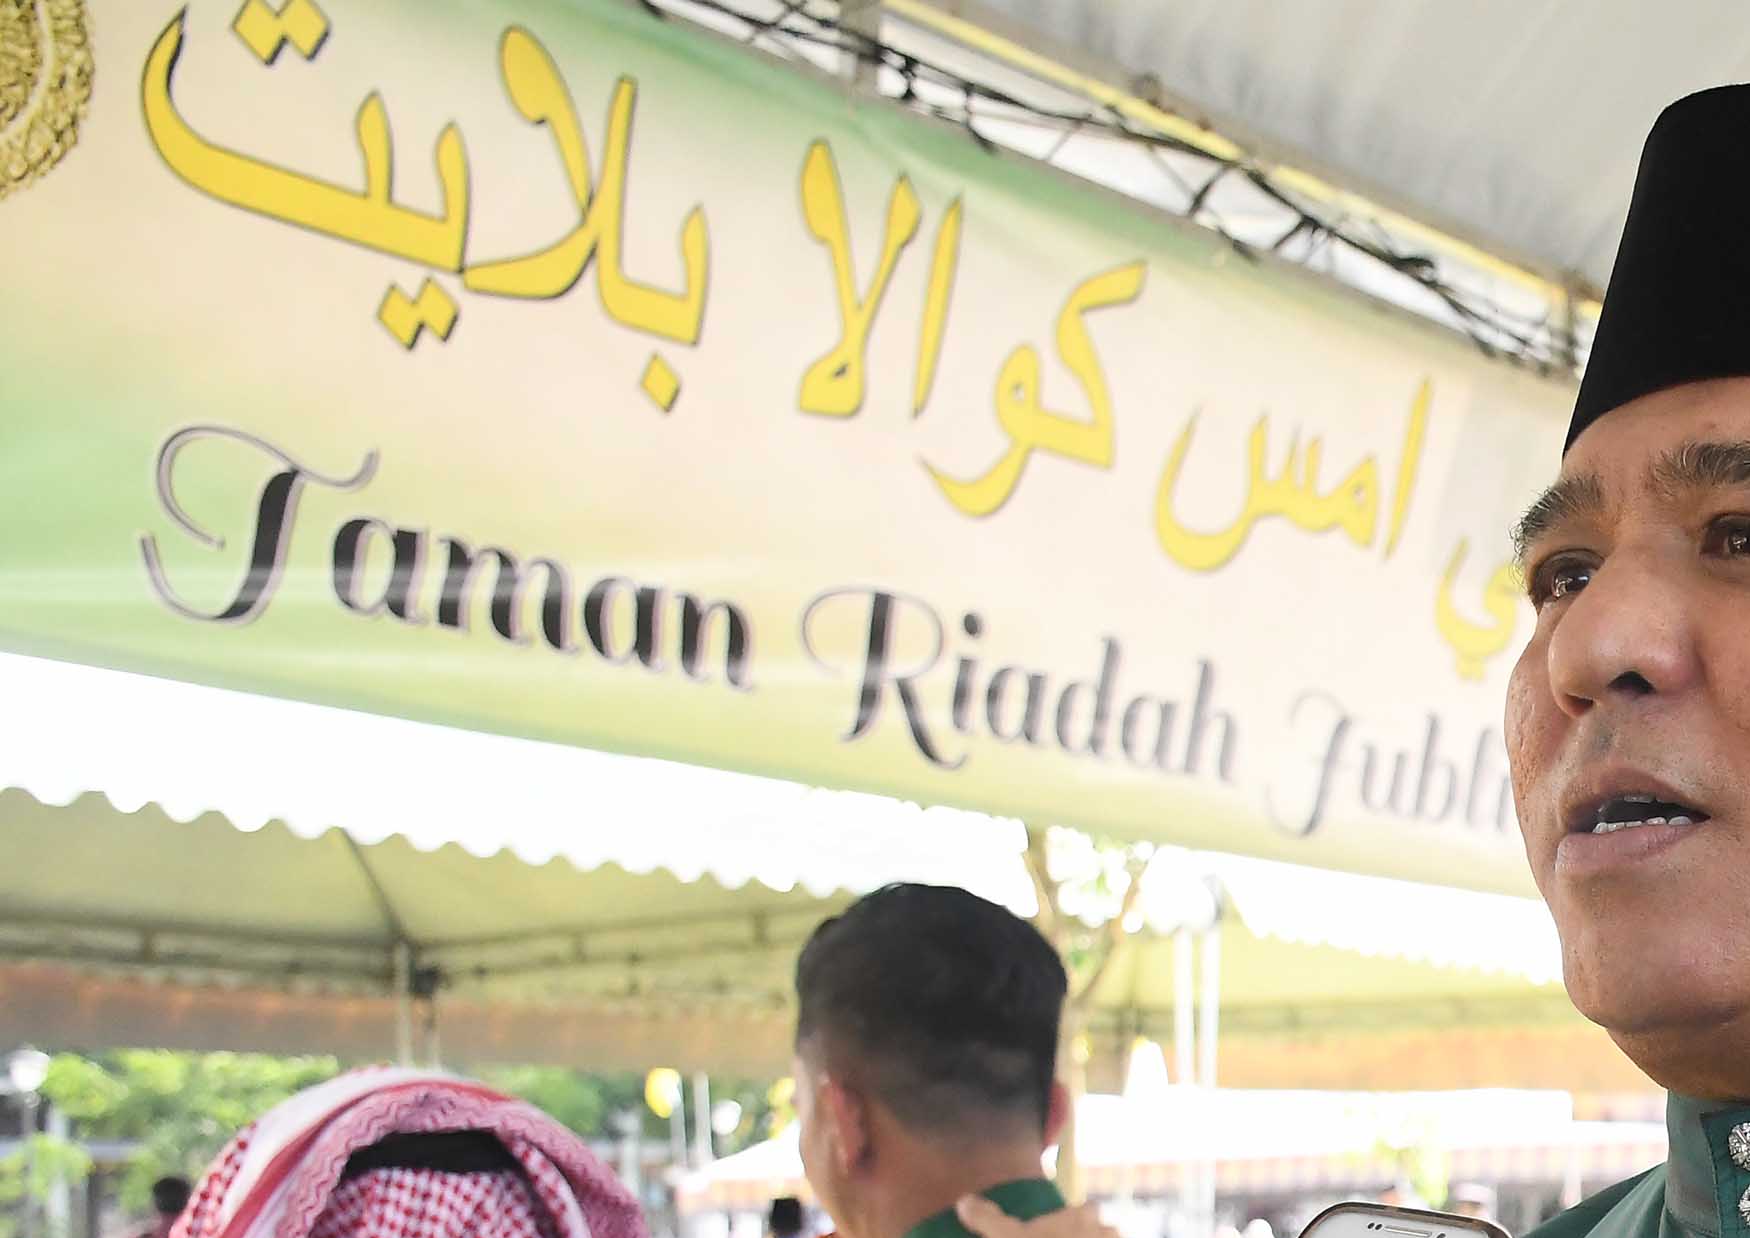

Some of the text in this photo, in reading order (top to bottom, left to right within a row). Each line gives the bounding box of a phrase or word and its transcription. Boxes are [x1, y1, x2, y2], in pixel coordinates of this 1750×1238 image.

[798, 136, 1150, 518] كوالا
[139, 425, 757, 691] Taman
[799, 586, 1240, 785] Riadah
